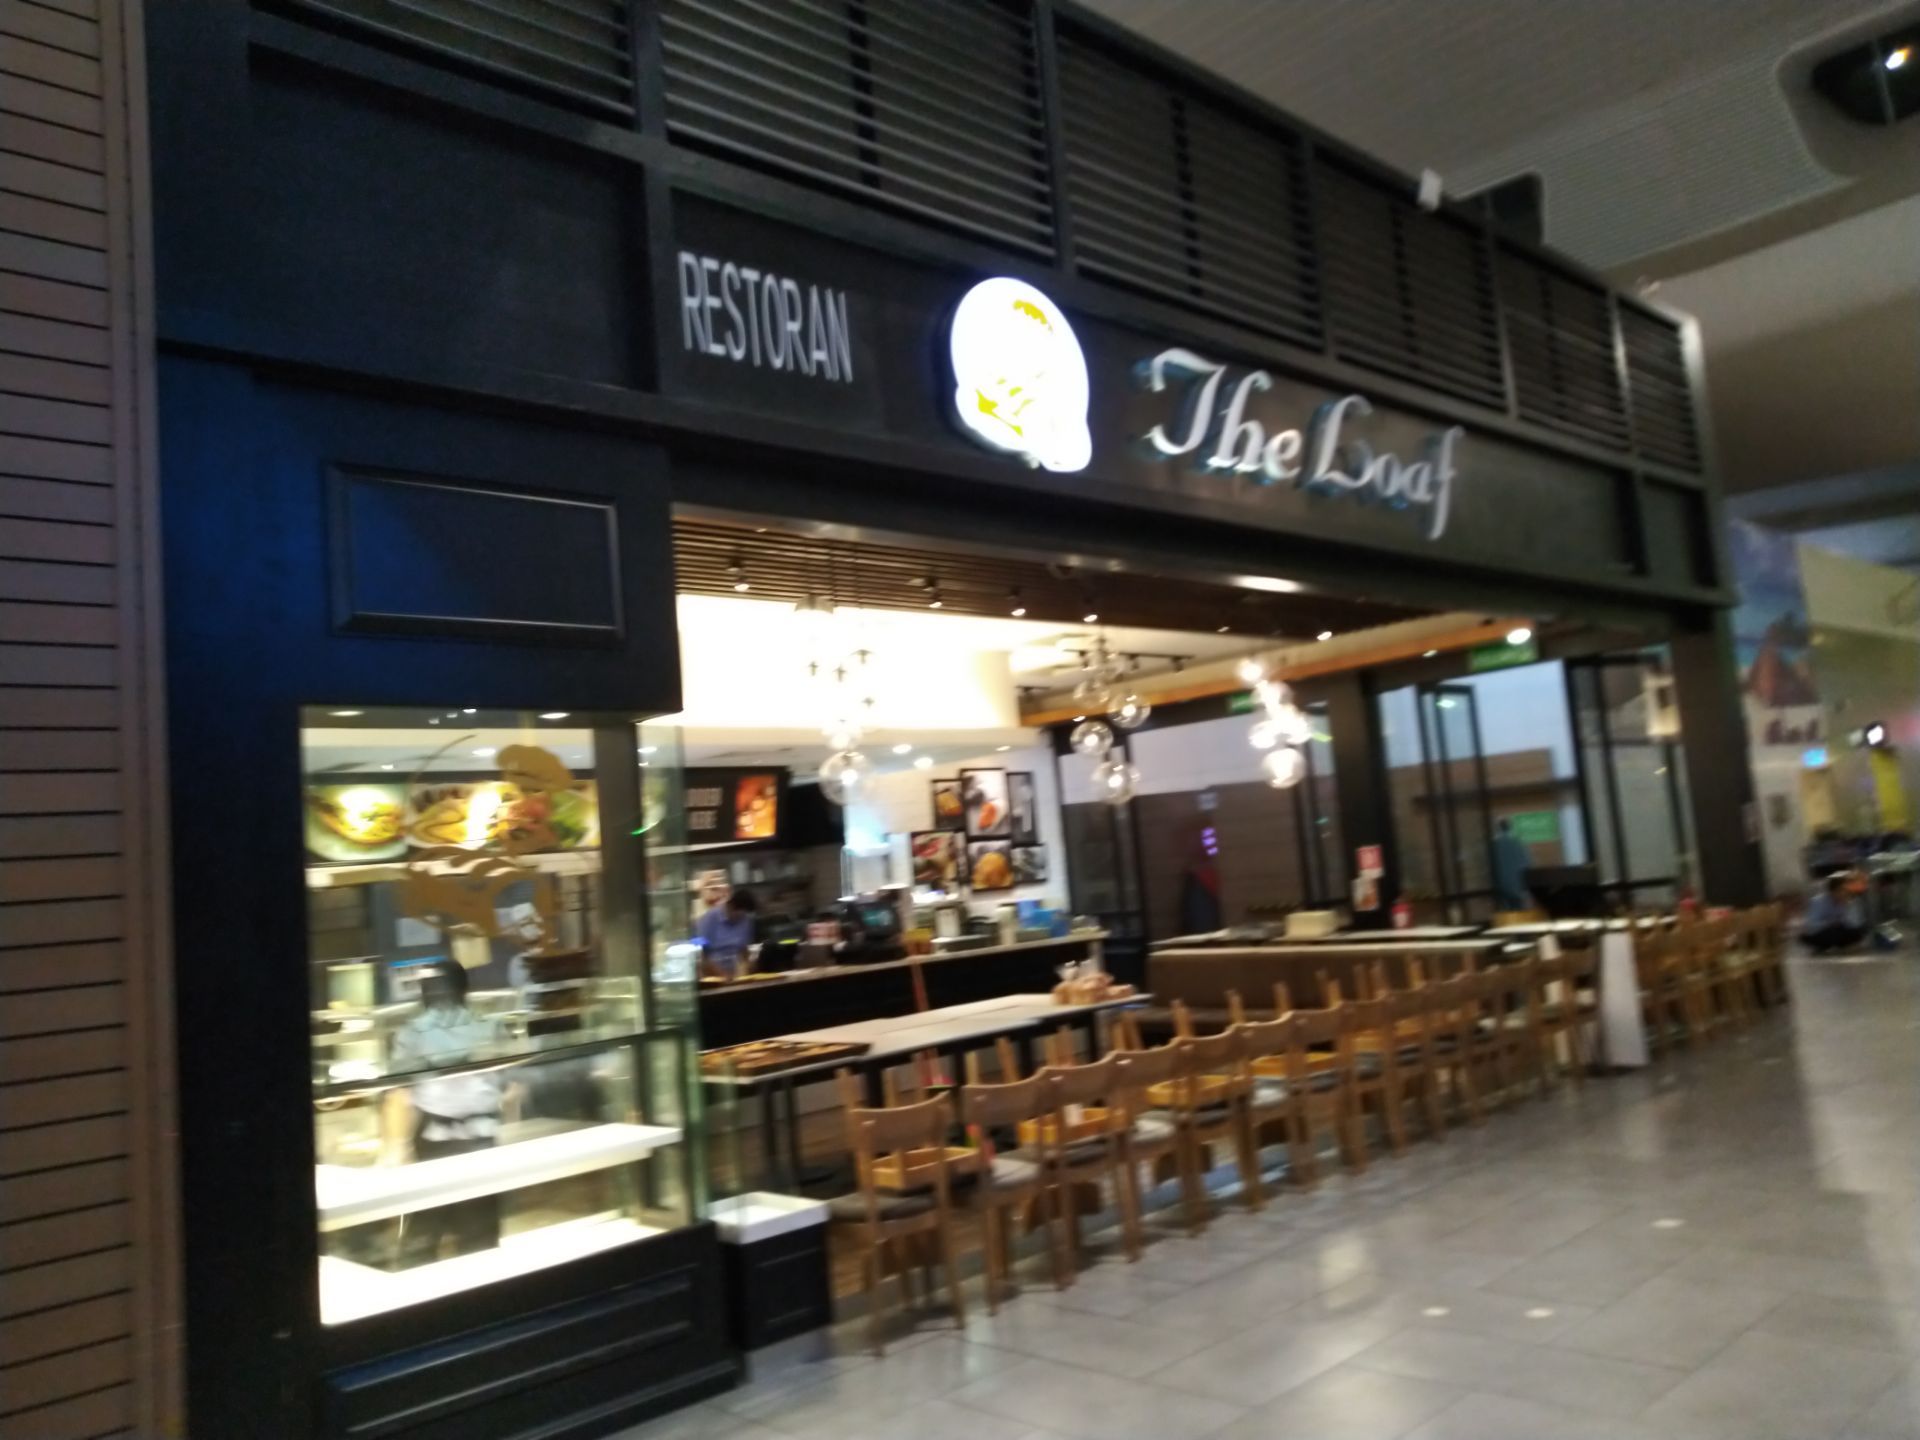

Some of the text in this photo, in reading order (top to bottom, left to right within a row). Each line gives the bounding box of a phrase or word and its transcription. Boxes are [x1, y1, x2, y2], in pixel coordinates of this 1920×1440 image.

[678, 251, 852, 382] RESTORAN
[1145, 348, 1464, 539] The Loaf
